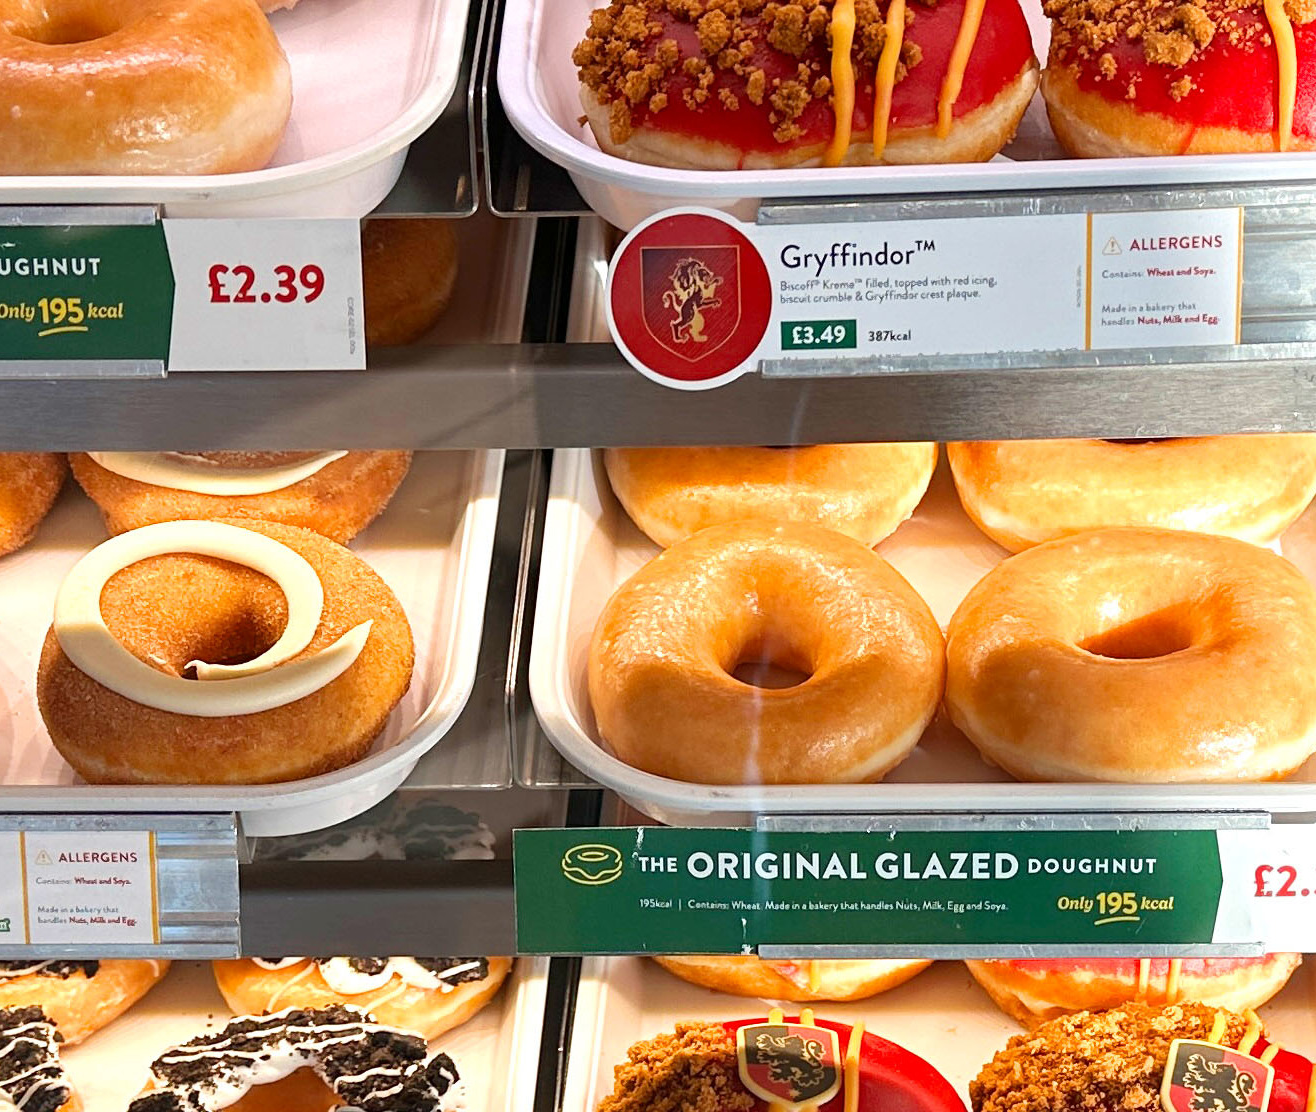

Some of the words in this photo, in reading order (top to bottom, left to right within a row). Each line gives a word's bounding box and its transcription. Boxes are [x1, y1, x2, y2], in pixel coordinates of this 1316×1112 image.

[1129, 235, 1223, 251] ALLERGENS
[1146, 267, 1175, 277] Wheat
[1176, 267, 1191, 276] and
[208, 264, 325, 303] £2.39
[894, 277, 928, 290] topped
[930, 276, 951, 286] with
[953, 275, 969, 286] red
[780, 293, 811, 304] biscuit
[813, 292, 852, 302] crumble
[865, 290, 917, 304] Gryffindor
[920, 290, 944, 299] crest
[946, 289, 981, 301] plaque.
[38, 297, 84, 324] 195
[87, 302, 123, 319] kcal
[1101, 304, 1126, 313] Made
[1145, 302, 1175, 313] bakery
[1177, 301, 1196, 310] that
[1163, 315, 1182, 324] Milk
[1184, 315, 1200, 323] and
[792, 325, 846, 345] £3.49
[868, 330, 911, 342] 387kcal
[58, 852, 138, 863] ALLERGENS
[638, 857, 678, 873] THE
[686, 851, 867, 879] ORIGINAL
[874, 852, 1019, 880] GLAZED
[1027, 858, 1157, 874] DOUGHNUT
[639, 898, 673, 909] 195kcal
[764, 900, 790, 911] Made
[792, 900, 800, 910] in
[808, 900, 838, 913] bakery
[839, 900, 858, 911] that
[860, 900, 894, 911] handles
[895, 900, 920, 912] Nuts,
[922, 901, 945, 911] Milk,
[947, 901, 965, 913] Egg
[966, 901, 982, 911] and
[1057, 896, 1094, 913] Only
[1096, 892, 1137, 915] 195
[1140, 895, 1174, 910] kcal
